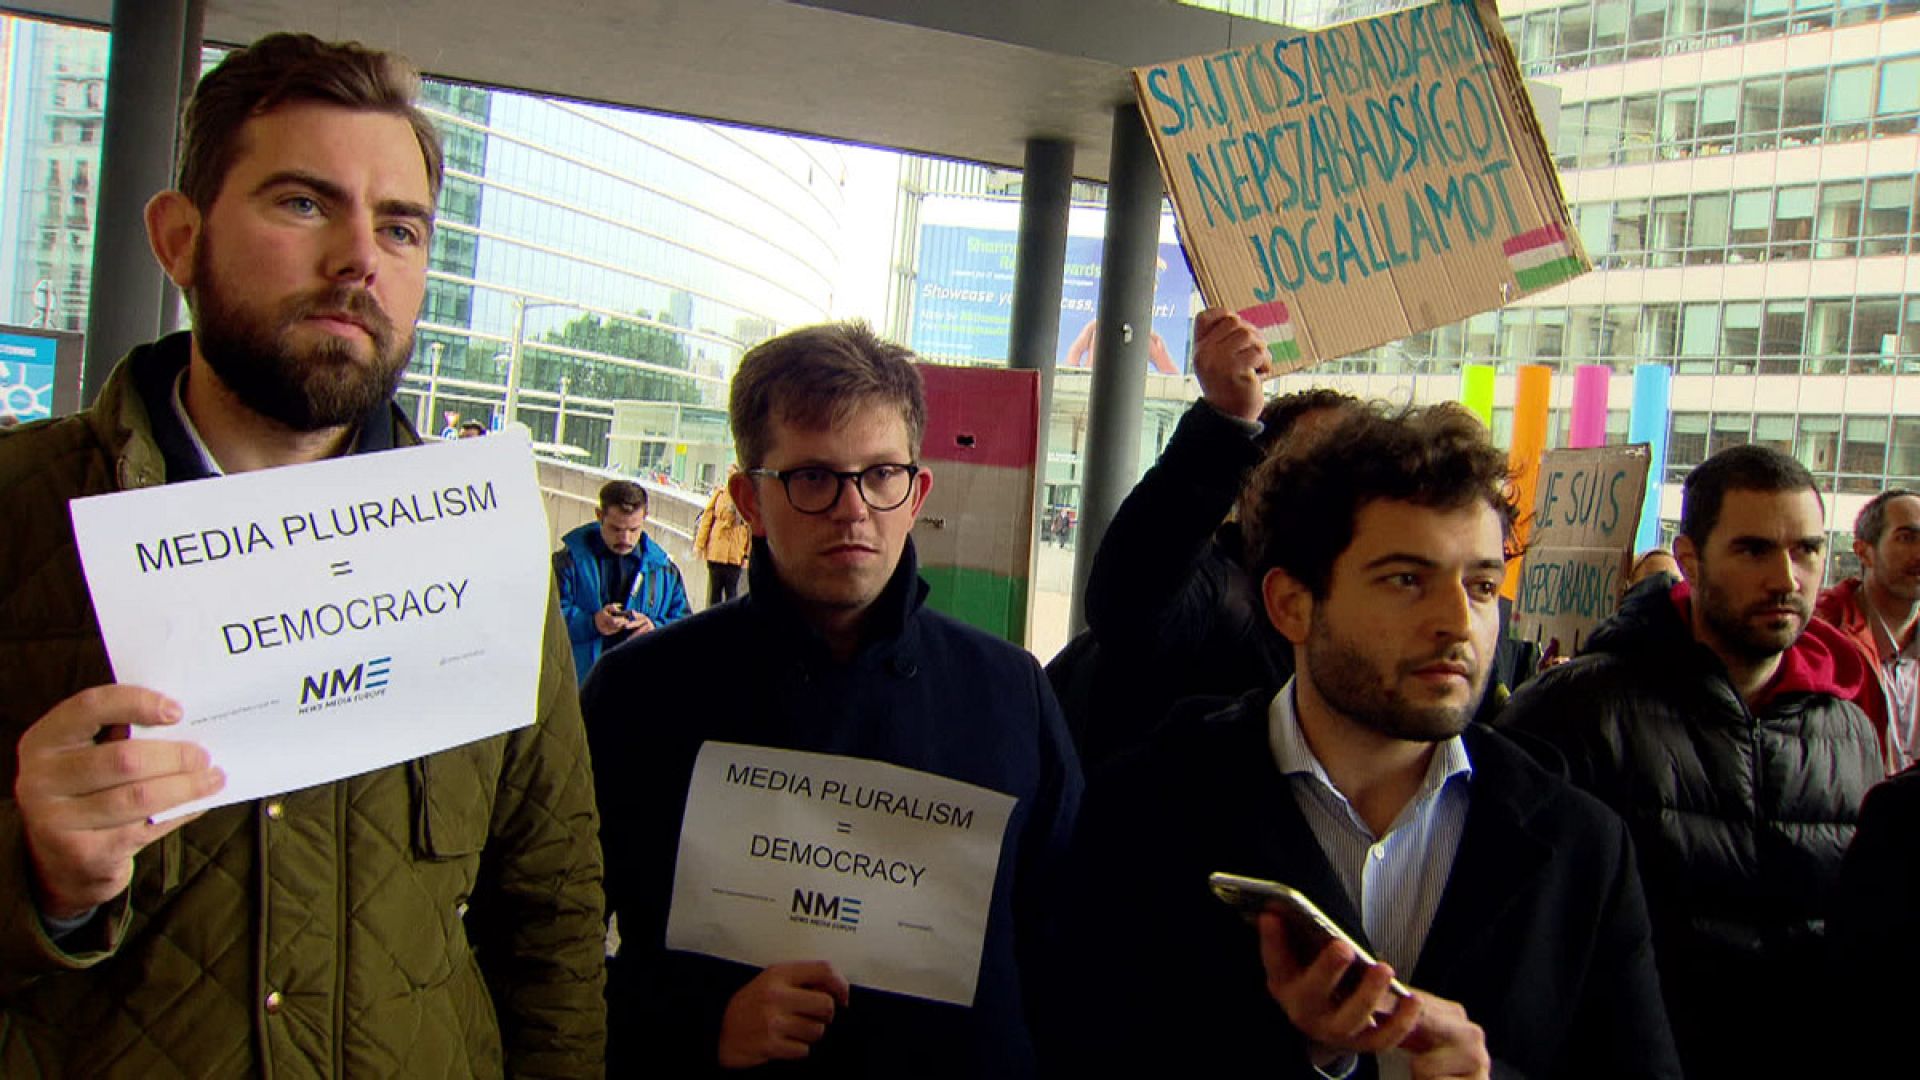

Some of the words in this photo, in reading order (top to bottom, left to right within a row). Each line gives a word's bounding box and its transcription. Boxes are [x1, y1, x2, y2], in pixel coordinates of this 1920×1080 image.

[1248, 160, 1521, 302] JOGÁLLAMOT
[922, 283, 994, 304] Showcase
[136, 521, 275, 573] MEDIA
[282, 482, 497, 547] PLURALISM
[1535, 471, 1564, 529] JE
[1565, 464, 1627, 536] SUIS
[222, 578, 469, 656] DEMOCRACY
[298, 703, 323, 716] NEWS
[325, 696, 352, 709] MEDIA
[354, 687, 387, 703] EUROPE
[300, 656, 392, 705] NME
[726, 763, 812, 797] MEDIA
[820, 780, 974, 829] PLURALISM
[750, 834, 926, 887] DEMOCRACY
[791, 887, 862, 924] NME
